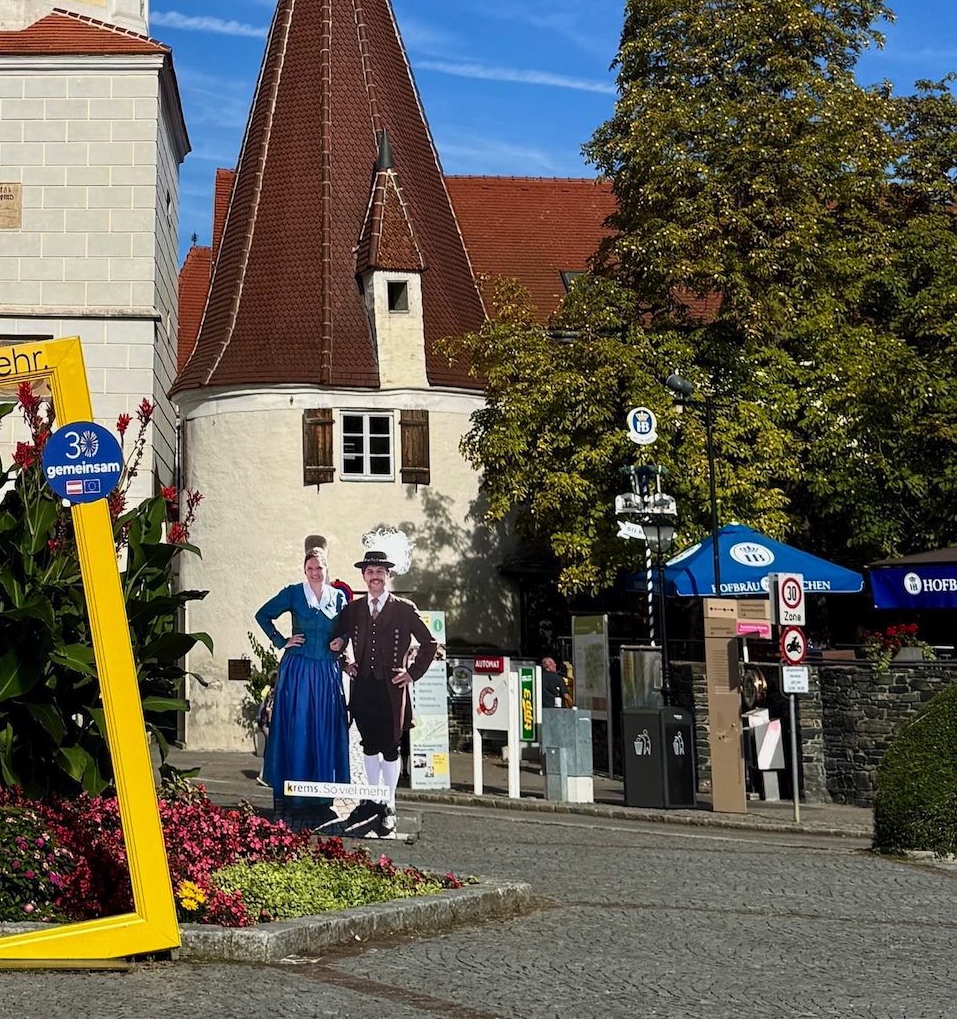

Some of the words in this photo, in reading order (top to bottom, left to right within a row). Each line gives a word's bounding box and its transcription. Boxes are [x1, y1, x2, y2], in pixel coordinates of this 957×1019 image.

[637, 421, 649, 432] HB
[65, 430, 99, 459] 30
[47, 461, 120, 479] gemeinsam
[787, 586, 796, 601] 30
[784, 611, 802, 621] Zone
[475, 660, 500, 669] AUTOMAT
[287, 783, 322, 793] krems.
[323, 784, 337, 794] So
[339, 785, 357, 795] viel
[359, 788, 388, 797] mehr
